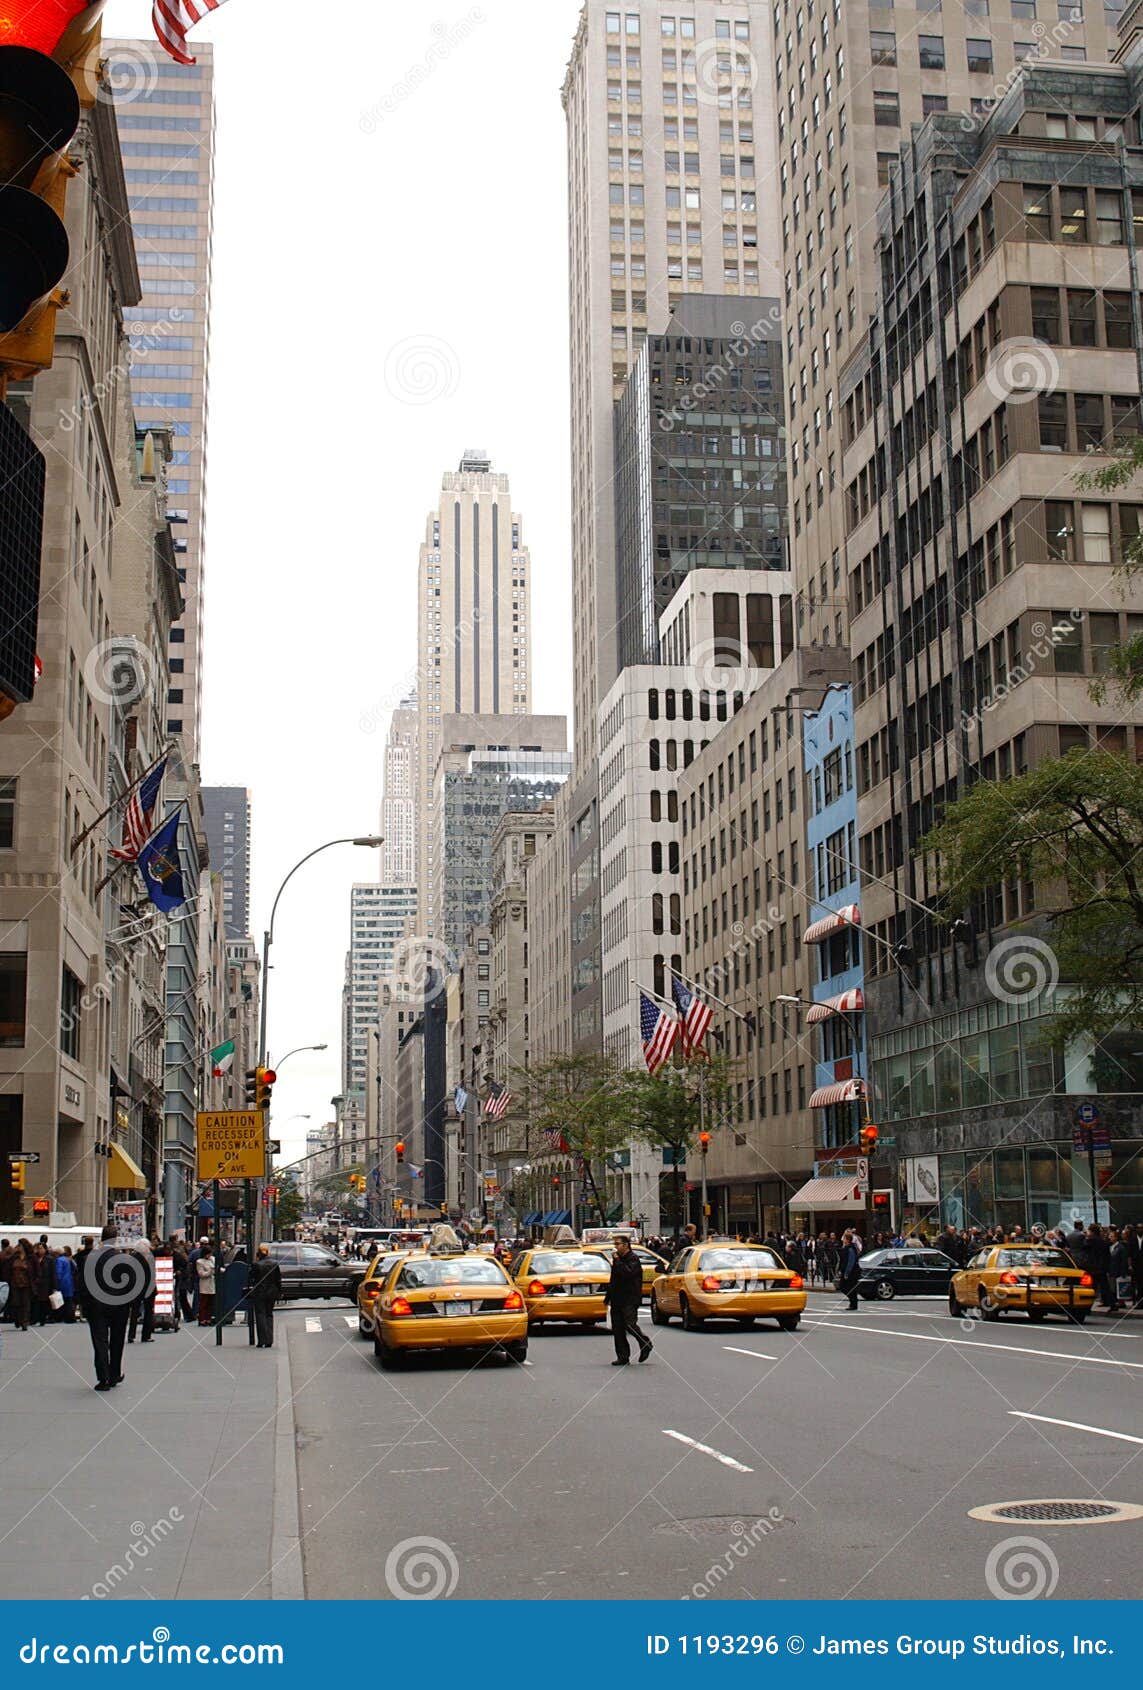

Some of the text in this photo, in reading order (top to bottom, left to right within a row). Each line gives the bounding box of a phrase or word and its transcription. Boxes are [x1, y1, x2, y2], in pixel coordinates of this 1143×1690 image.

[206, 1115, 255, 1127] CAUTION
[205, 1129, 256, 1140] RECESSED
[201, 1140, 260, 1151] CROSSWALK
[224, 1151, 239, 1161] ON
[218, 1162, 247, 1173] 5 AVE
